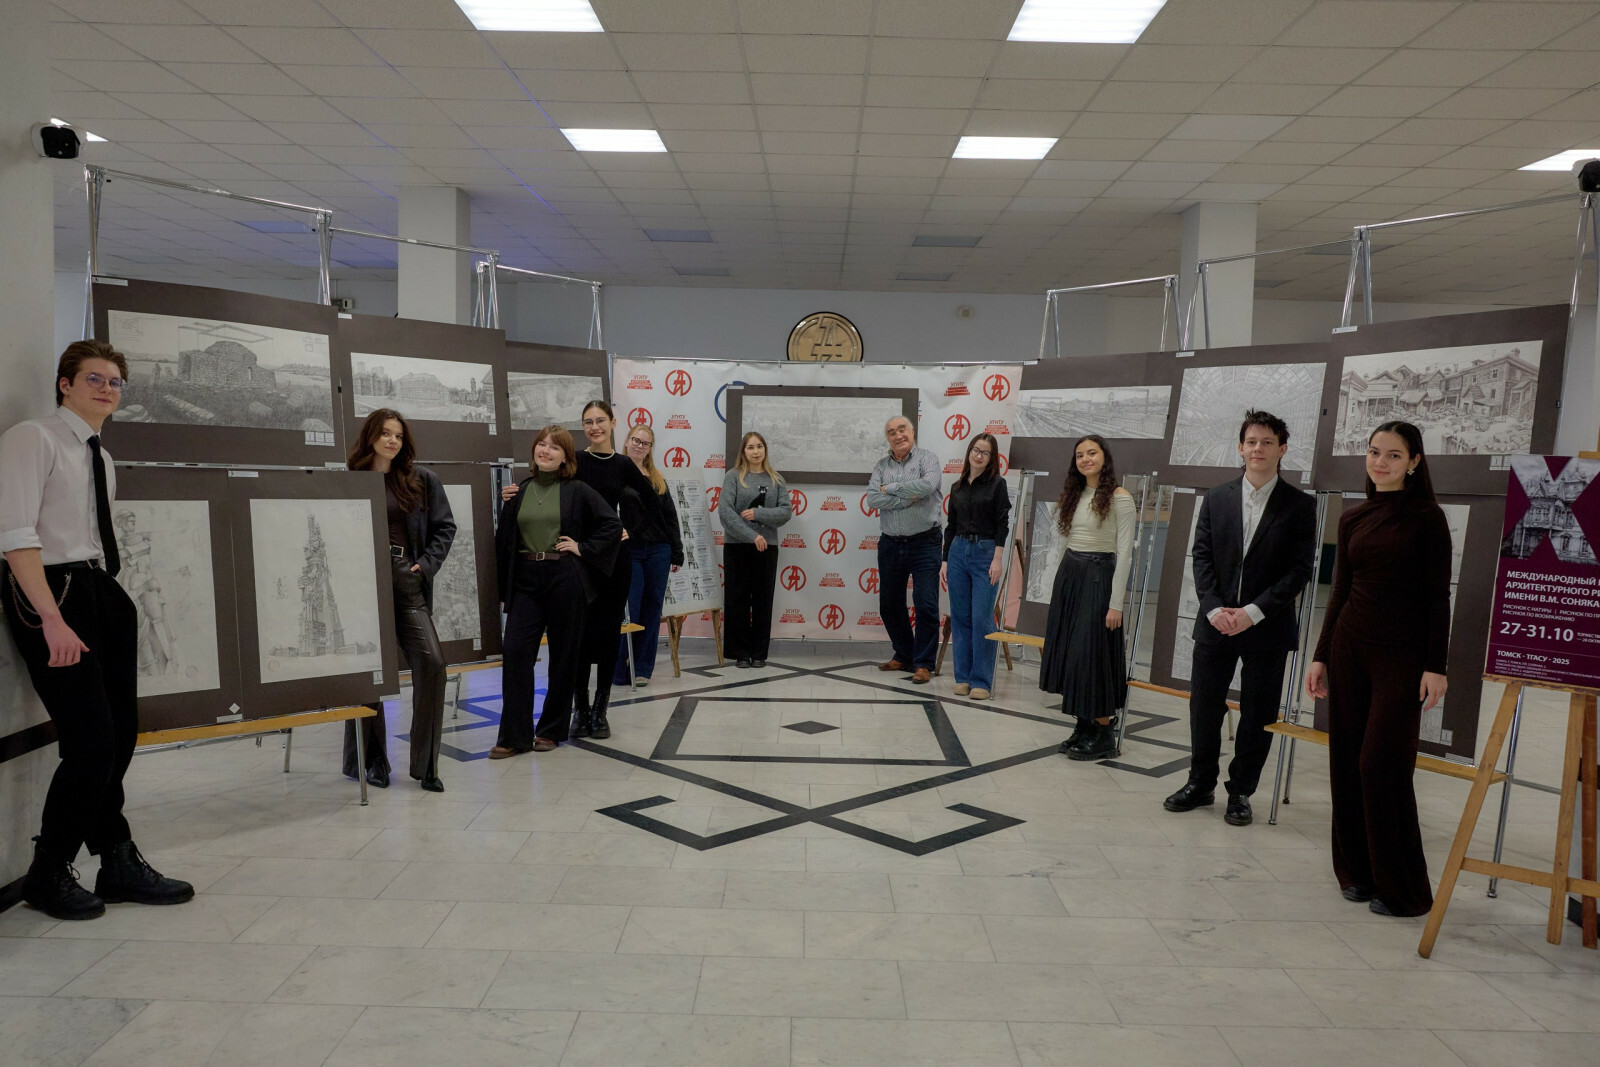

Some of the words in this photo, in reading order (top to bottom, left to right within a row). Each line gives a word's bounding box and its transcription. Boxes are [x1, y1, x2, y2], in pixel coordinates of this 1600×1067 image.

[1507, 570, 1596, 586] МЕЖДУНАРОДНЫЙ
[1506, 581, 1590, 596] АРХИТЕКТУРНОГО
[1504, 592, 1538, 602] ИМЕНИ
[1540, 594, 1559, 603] В.М.
[1500, 622, 1574, 642] 27-31.10
[1497, 650, 1521, 659] ТОМСК
[1527, 654, 1547, 662] ТГАСУ
